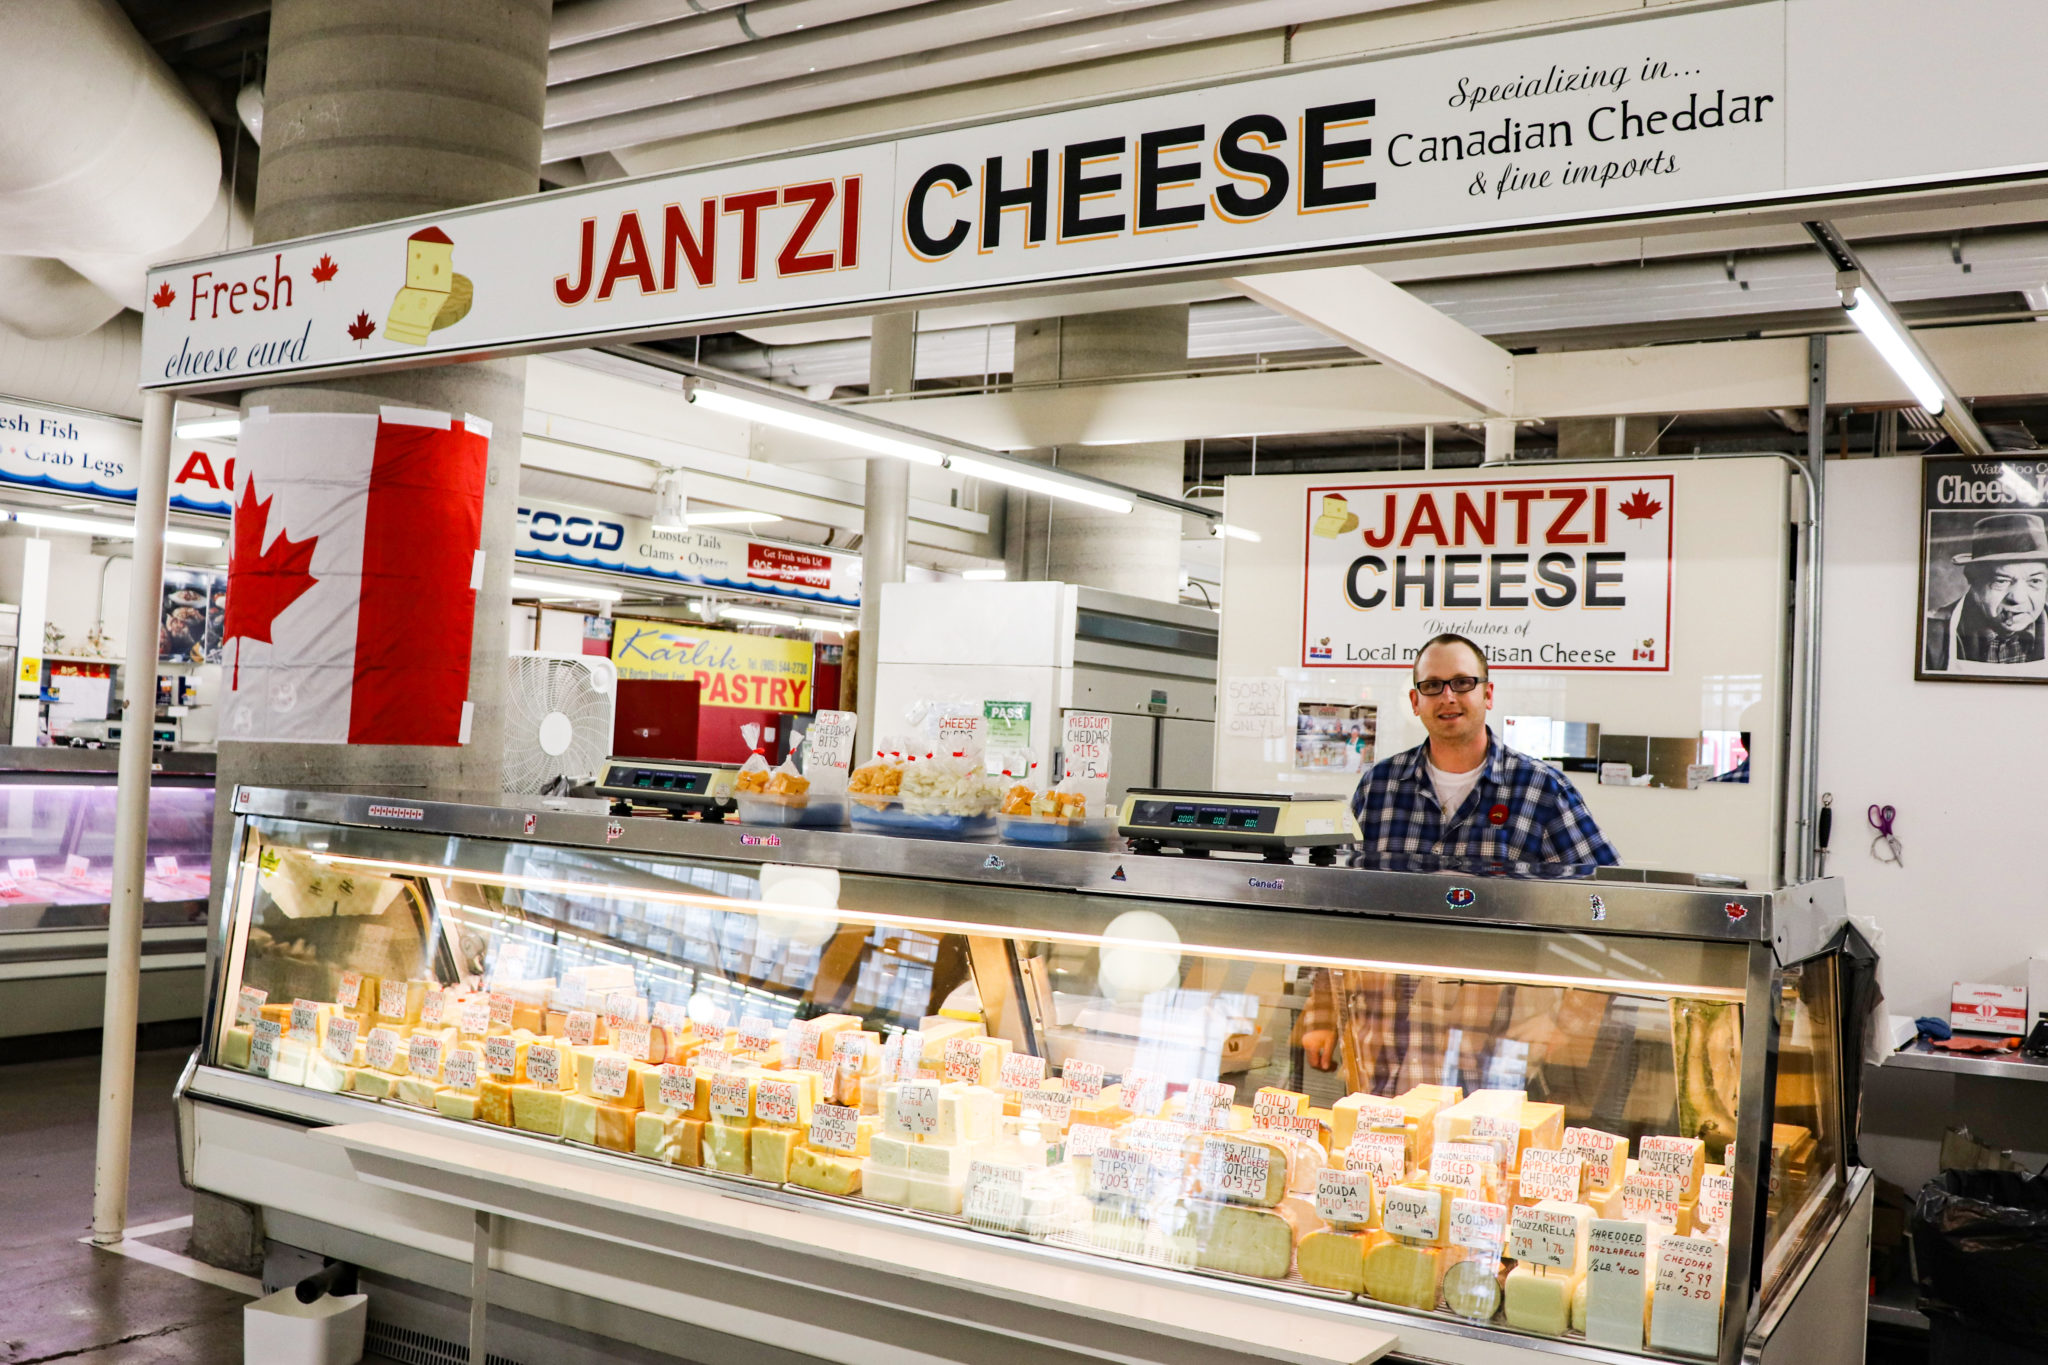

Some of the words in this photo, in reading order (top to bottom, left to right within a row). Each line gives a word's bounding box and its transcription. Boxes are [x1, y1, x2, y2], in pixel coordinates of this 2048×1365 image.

[1449, 63, 1631, 113] Specializing
[1387, 121, 1574, 169] Canadian
[1587, 89, 1776, 143] Cheddar
[1468, 172, 1491, 199] &
[1496, 162, 1556, 201] fine
[1561, 148, 1682, 191] imports
[553, 173, 864, 307] JANTZI
[902, 98, 1378, 264] CHEESE
[189, 254, 295, 321] Fresh
[165, 337, 240, 379] cheese
[246, 319, 314, 370] curd
[38, 418, 80, 441] Fish
[24, 444, 74, 467] Crab
[82, 453, 125, 479] Legs
[1362, 485, 1609, 550] JANTZI
[651, 528, 693, 546] Lobster
[697, 534, 722, 551] Tails
[639, 543, 675, 563] Clams
[688, 551, 730, 571] Oysters
[1343, 551, 1627, 613] CHEESE
[1423, 618, 1509, 636] Distributors
[1514, 618, 1532, 638] of
[618, 628, 742, 671] Karlik
[1345, 643, 1397, 662] Local
[1539, 643, 1617, 664] Cheese
[693, 669, 808, 708] PASTRY
[991, 707, 1025, 720] PASS
[1237, 702, 1277, 716] CASH
[939, 717, 979, 730] CHEESE
[1069, 716, 1110, 730] MEDIUM
[818, 735, 839, 748] BITS
[1067, 729, 1110, 744] CHEDDAR
[740, 833, 781, 848] Canada
[1248, 877, 1285, 890] Canada
[531, 1047, 557, 1062] SWISS
[965, 1042, 982, 1055] OLD
[944, 1051, 981, 1068] CHEDDAR
[660, 1076, 692, 1091] CHEDDAR
[712, 1073, 746, 1089] SWISS
[1062, 1069, 1100, 1084] CHEDDAR
[711, 1084, 748, 1099] GRUYERE
[759, 1080, 792, 1099] SWISS
[901, 1086, 934, 1102] FETA
[1024, 1090, 1072, 1105] GORGONZOLA
[1261, 1093, 1290, 1109] MILD
[814, 1104, 859, 1122] JARLSBERG
[819, 1117, 846, 1131] SWISS
[1270, 1115, 1289, 1128] OLD
[1292, 1116, 1319, 1131] DUTCH
[1353, 1131, 1407, 1147] HORSERADISH
[1566, 1129, 1575, 1144] 8
[1591, 1134, 1614, 1151] OLD
[1642, 1138, 1666, 1151] PART
[1668, 1141, 1694, 1154] SKIM
[1127, 1153, 1146, 1165] HILL
[1240, 1143, 1263, 1159] HILL
[1348, 1148, 1381, 1163] AGED
[1524, 1150, 1575, 1165] SMOKED
[1640, 1149, 1694, 1168] MONTEREY
[1100, 1160, 1138, 1176] TIPSY
[1241, 1156, 1269, 1169] CHEESE
[1346, 1160, 1384, 1176] GOUDA
[1433, 1159, 1475, 1175] SPICED
[1522, 1160, 1581, 1177] APPLEWOOD
[1652, 1161, 1680, 1174] JACK
[1319, 1171, 1370, 1186] MEDIUM
[1434, 1172, 1472, 1187] GOUDA
[1521, 1171, 1570, 1189] CHEDDAR
[1626, 1175, 1674, 1191] SMOKED
[1319, 1183, 1358, 1197] GOUDA
[1624, 1186, 1673, 1202] GRUYERE
[1388, 1200, 1429, 1216] GOUDA
[1457, 1212, 1496, 1227] GOUDA
[1512, 1217, 1577, 1238] MOZZARELLA
[1591, 1228, 1643, 1243] SHREDDED
[1589, 1244, 1646, 1258] MOZZARELLA
[1663, 1239, 1713, 1254] SHREDDED
[1663, 1253, 1713, 1271] CHEDDAR
